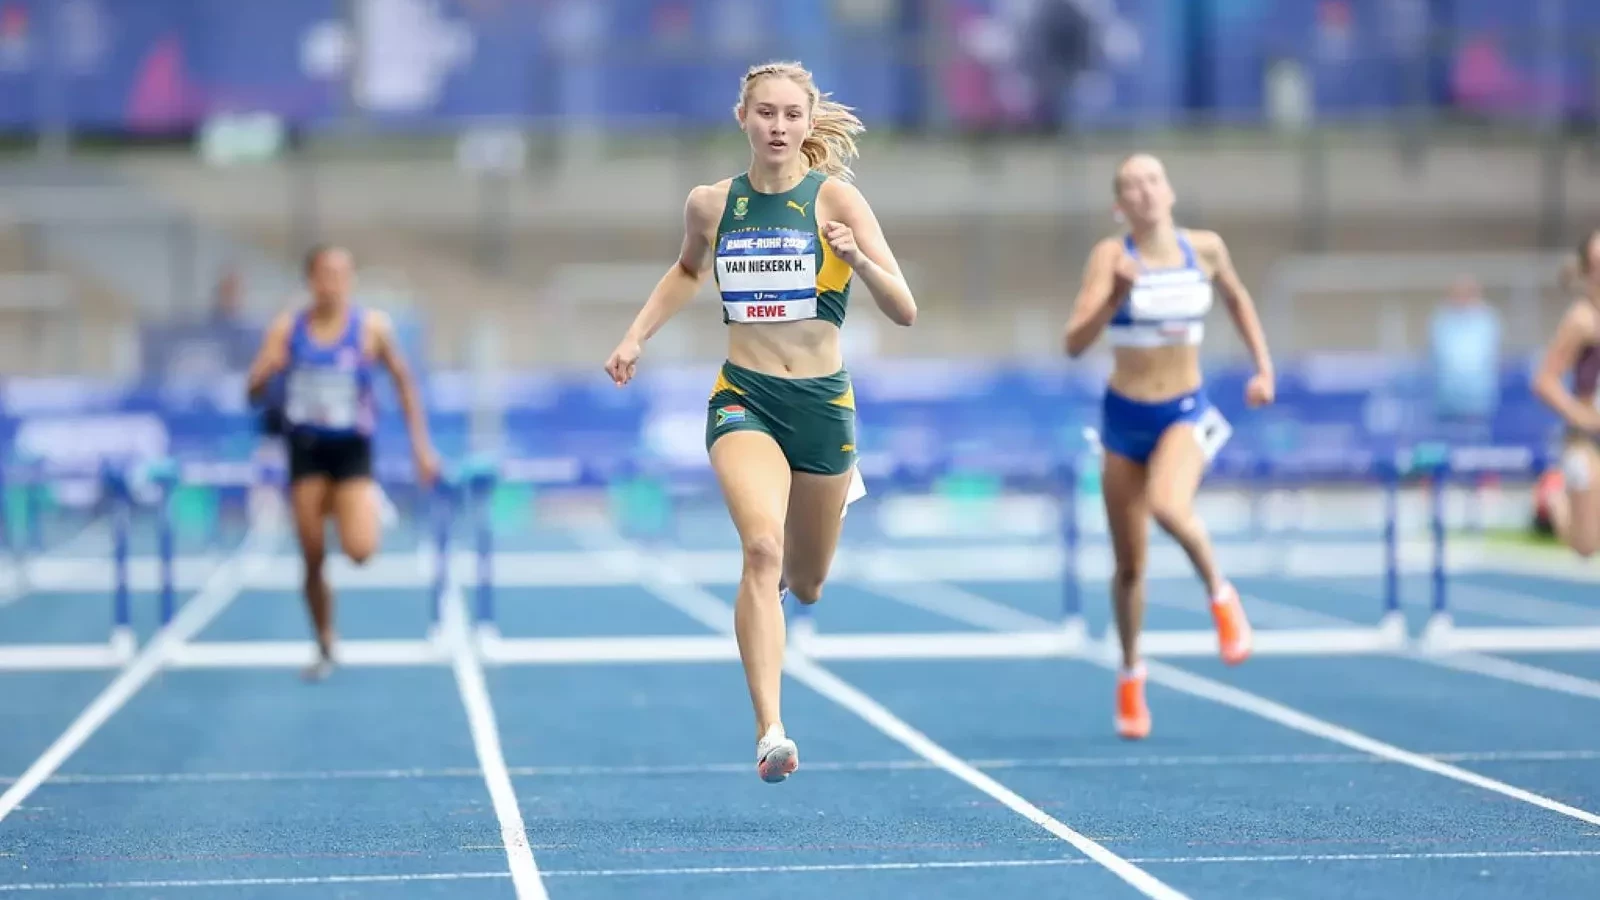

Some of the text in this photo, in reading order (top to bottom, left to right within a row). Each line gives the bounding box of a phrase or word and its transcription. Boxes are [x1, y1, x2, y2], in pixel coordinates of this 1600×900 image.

[726, 259, 806, 273] VAN NIEKERK H.
[747, 305, 786, 317] REWE
